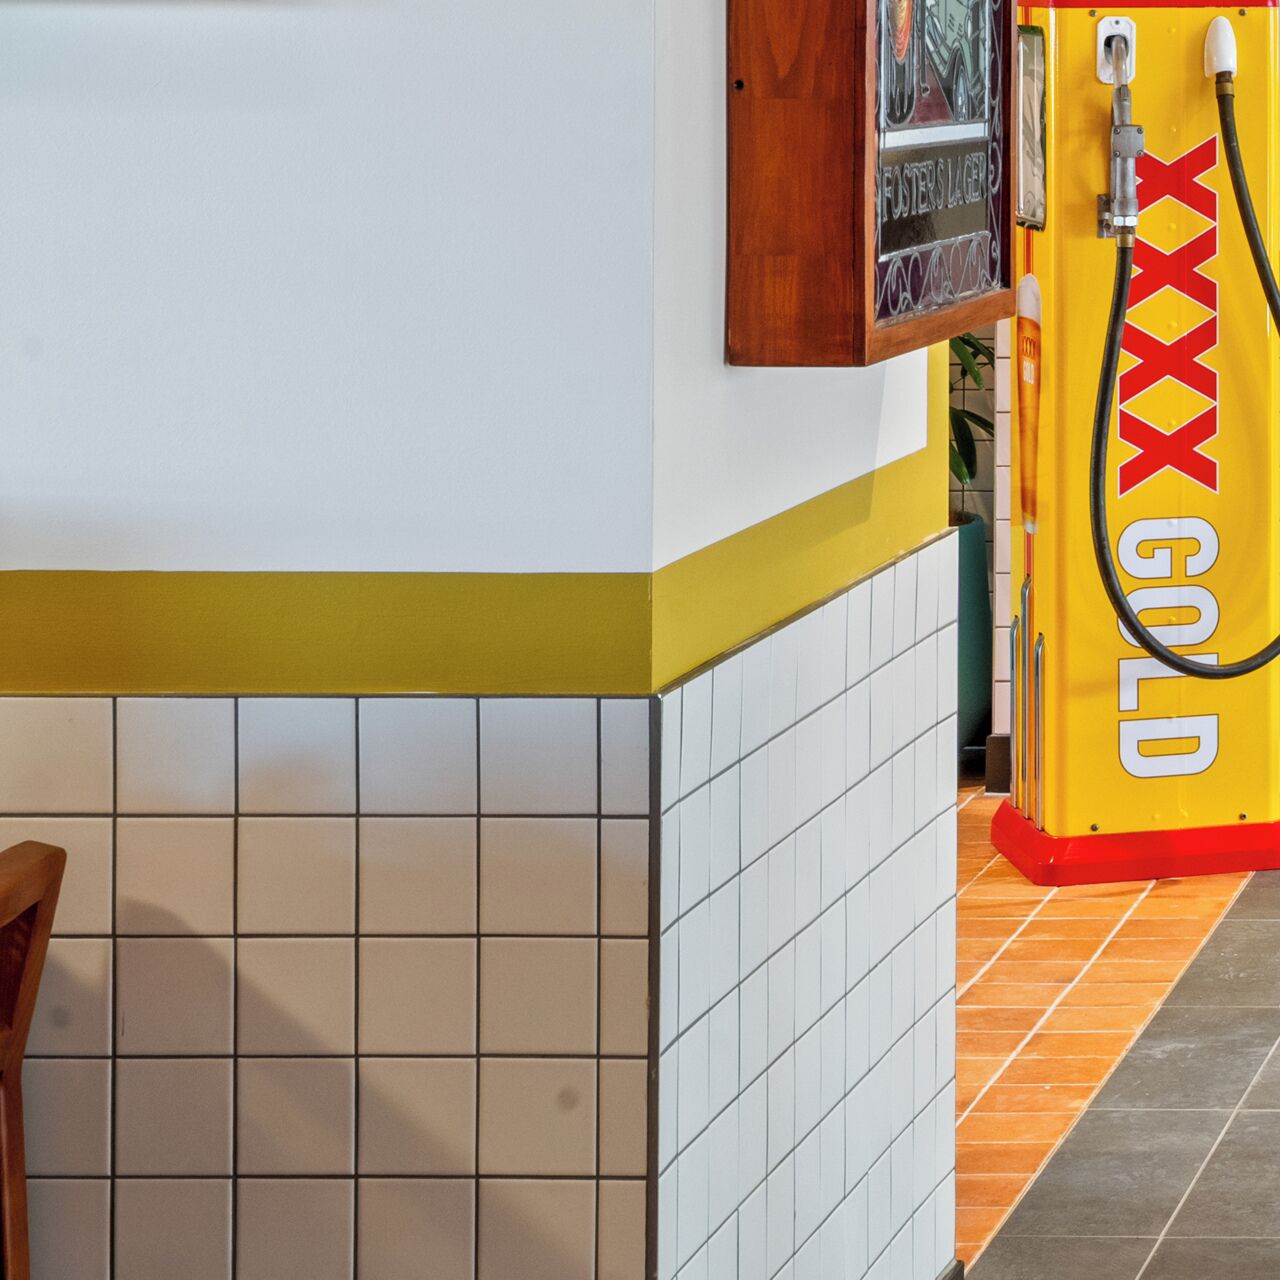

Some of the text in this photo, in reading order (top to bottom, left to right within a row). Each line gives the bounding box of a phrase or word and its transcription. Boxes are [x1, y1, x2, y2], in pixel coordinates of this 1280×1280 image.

[945, 151, 988, 210] LAGER
[1118, 133, 1220, 498] XXXX
[1117, 516, 1220, 779] GOLD
